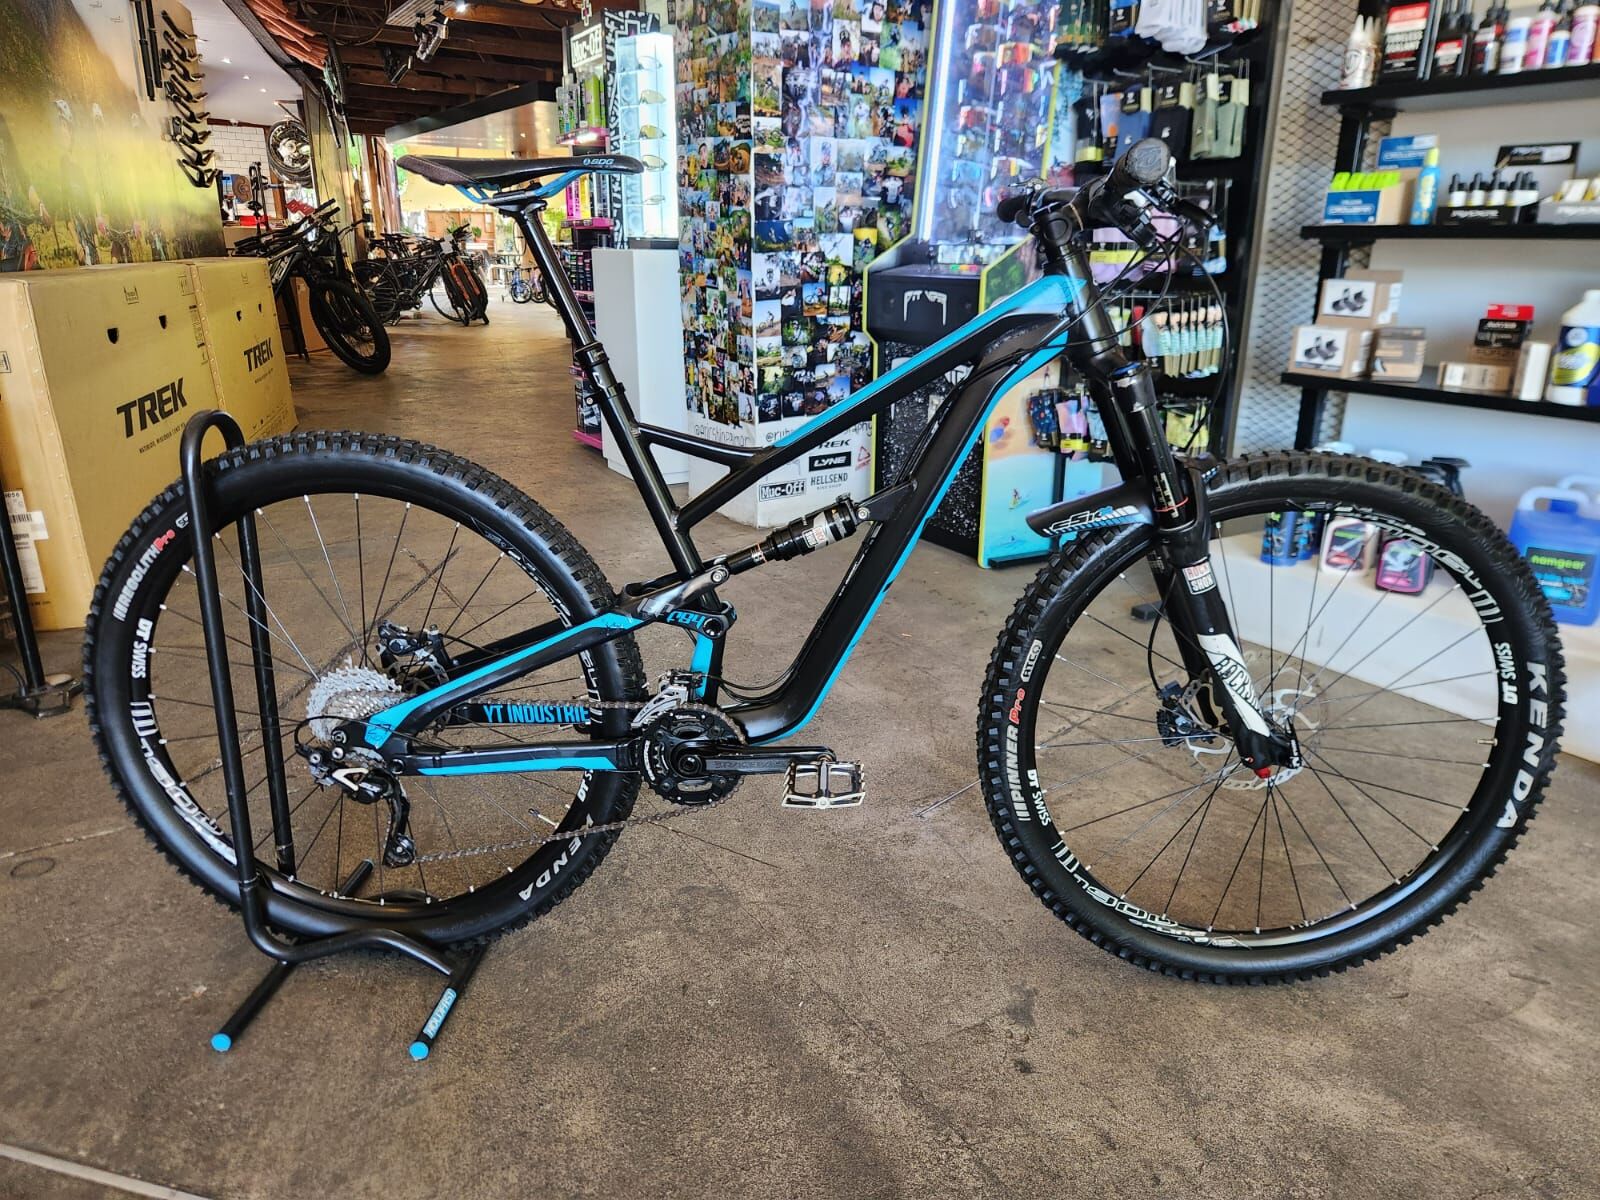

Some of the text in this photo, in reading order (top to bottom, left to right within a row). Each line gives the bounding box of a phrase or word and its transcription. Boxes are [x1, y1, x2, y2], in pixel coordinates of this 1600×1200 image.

[244, 337, 273, 373] TREK
[116, 377, 188, 439] TREK
[813, 455, 847, 467] LYNE
[819, 439, 852, 449] REK
[761, 480, 805, 499] Muc-Off
[810, 472, 848, 486] HELLSEND
[131, 617, 153, 679] DT SWISS
[1495, 641, 1518, 705] DT SWISS
[484, 704, 590, 724] YT INDUSTRIE
[1009, 688, 1026, 724] Pro
[1496, 661, 1549, 828] KENDA
[1027, 769, 1051, 827] DT SWISS
